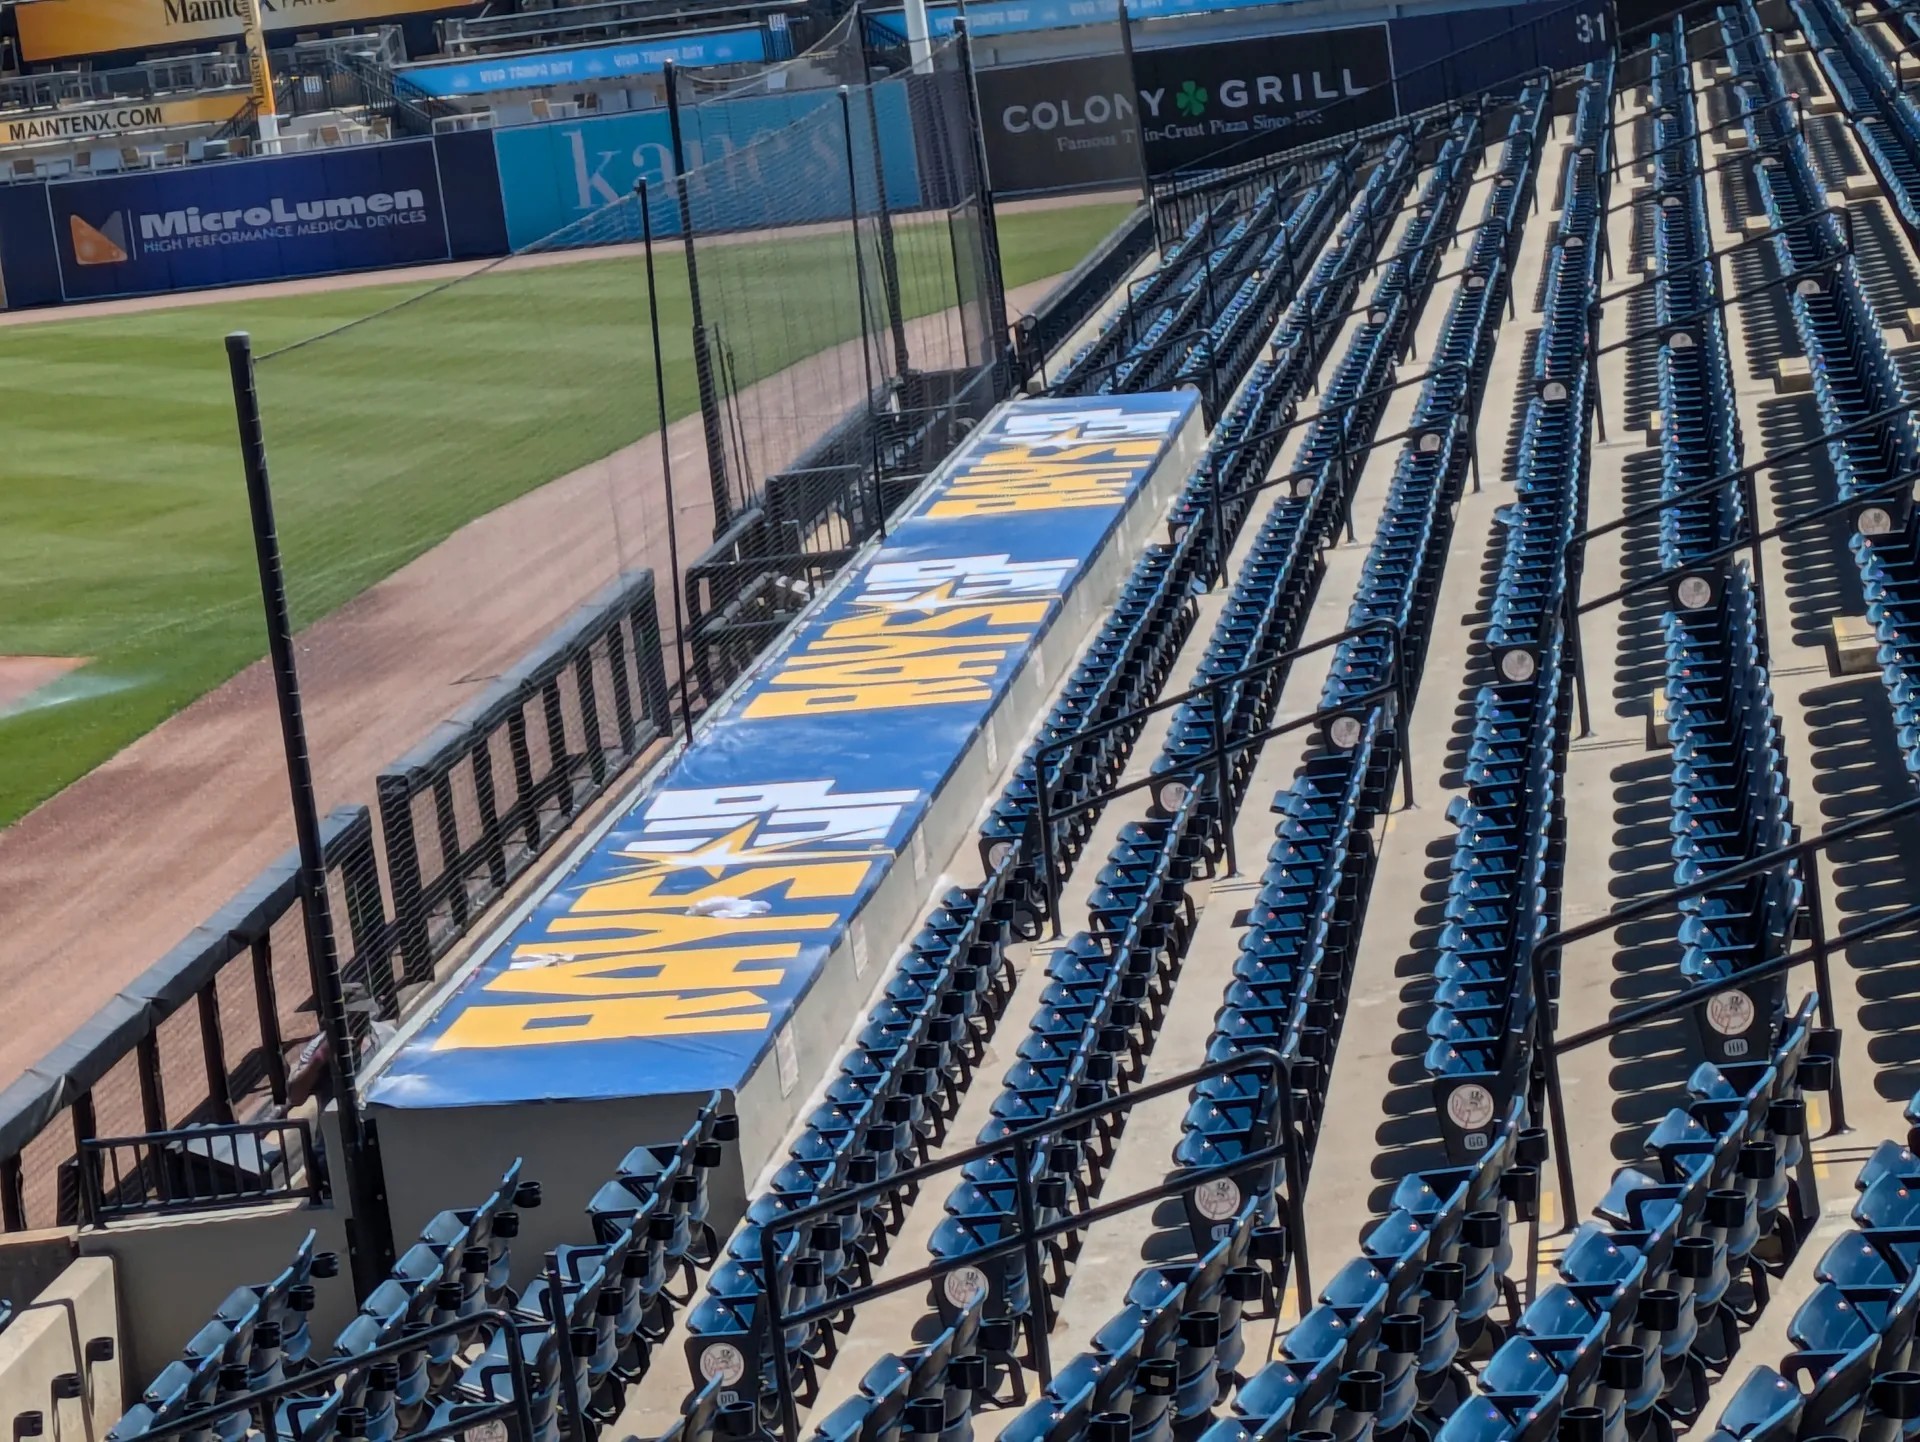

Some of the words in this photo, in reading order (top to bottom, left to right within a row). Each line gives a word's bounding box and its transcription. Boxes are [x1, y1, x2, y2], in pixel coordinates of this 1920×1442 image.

[1576, 12, 1606, 43] 31
[9, 107, 163, 140] MAINTENX.COM
[1002, 87, 1165, 133] COLONY
[1219, 68, 1369, 108] GRILL
[1121, 122, 1205, 144] Tin-Crust
[140, 189, 425, 239] MicroLumen
[144, 239, 182, 253] HIGH
[187, 226, 292, 249] PERFORMANCE
[297, 218, 362, 235] MEDICAL
[366, 210, 427, 228] DEVICES
[926, 439, 1162, 518] RAYS
[855, 554, 1079, 601] UP
[740, 601, 1050, 718] RAYS
[624, 779, 920, 852] UP
[432, 860, 872, 1051] RAYS
